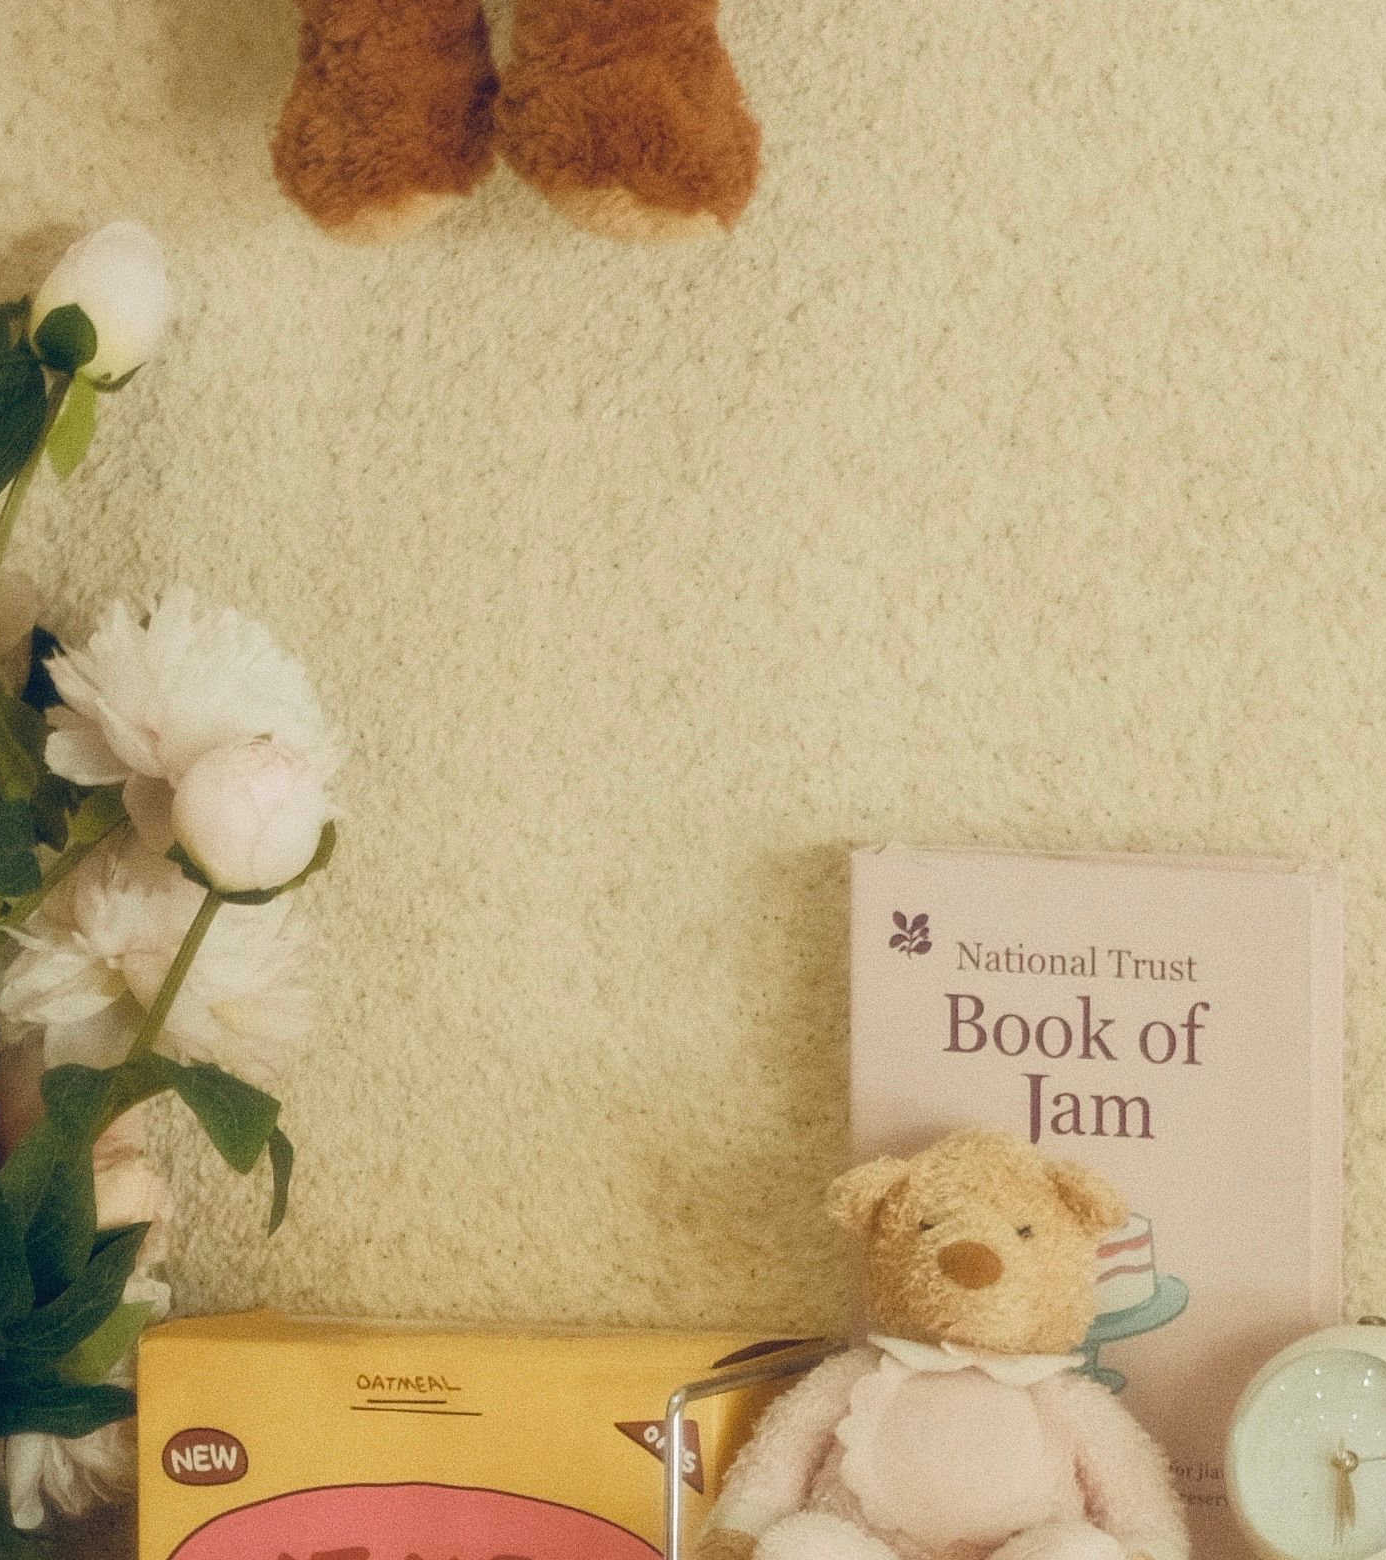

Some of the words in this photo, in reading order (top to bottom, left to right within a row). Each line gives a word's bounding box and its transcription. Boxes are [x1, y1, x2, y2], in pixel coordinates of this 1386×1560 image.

[957, 941, 1097, 977] National
[1108, 948, 1197, 982] Trust
[943, 993, 1118, 1060] Book
[1138, 1001, 1211, 1066] of
[1022, 1073, 1155, 1145] Jam
[355, 1373, 462, 1393] OATMEAL
[170, 1443, 238, 1474] NEW
[643, 1425, 697, 1474] OS
